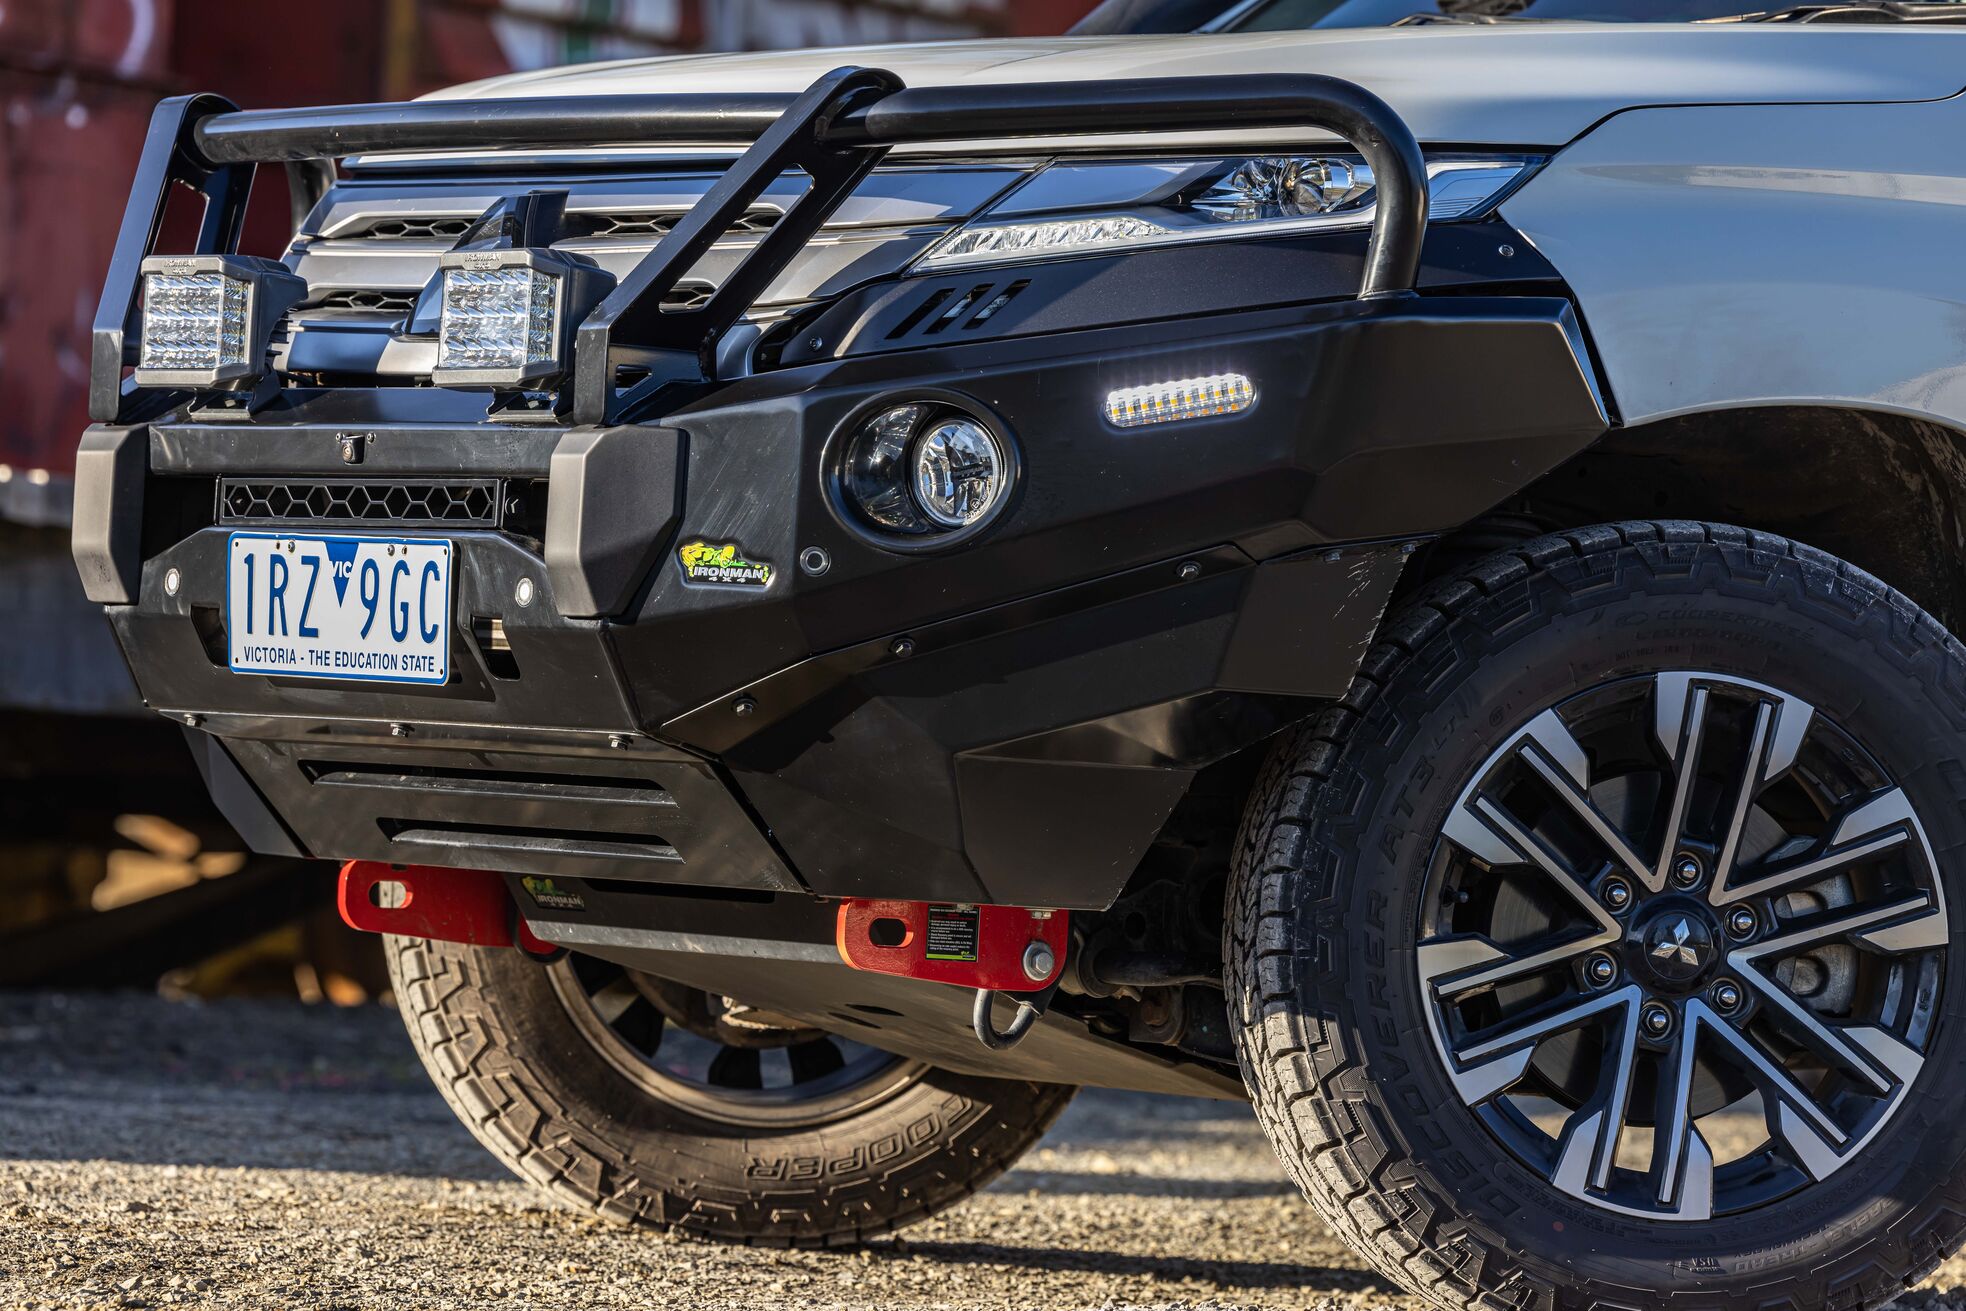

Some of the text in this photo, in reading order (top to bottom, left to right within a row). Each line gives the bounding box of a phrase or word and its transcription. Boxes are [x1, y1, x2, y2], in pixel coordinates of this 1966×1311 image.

[331, 561, 352, 578] VIC
[693, 566, 764, 579] IRONMAN
[243, 553, 441, 644] 1RZ 9GC
[244, 646, 297, 665] VICTORIA
[309, 649, 331, 667] THE
[334, 651, 398, 671] EDUCATION
[401, 655, 435, 673] STATE
[537, 894, 582, 905] IRONMAN
[746, 1094, 974, 1181] COOPER
